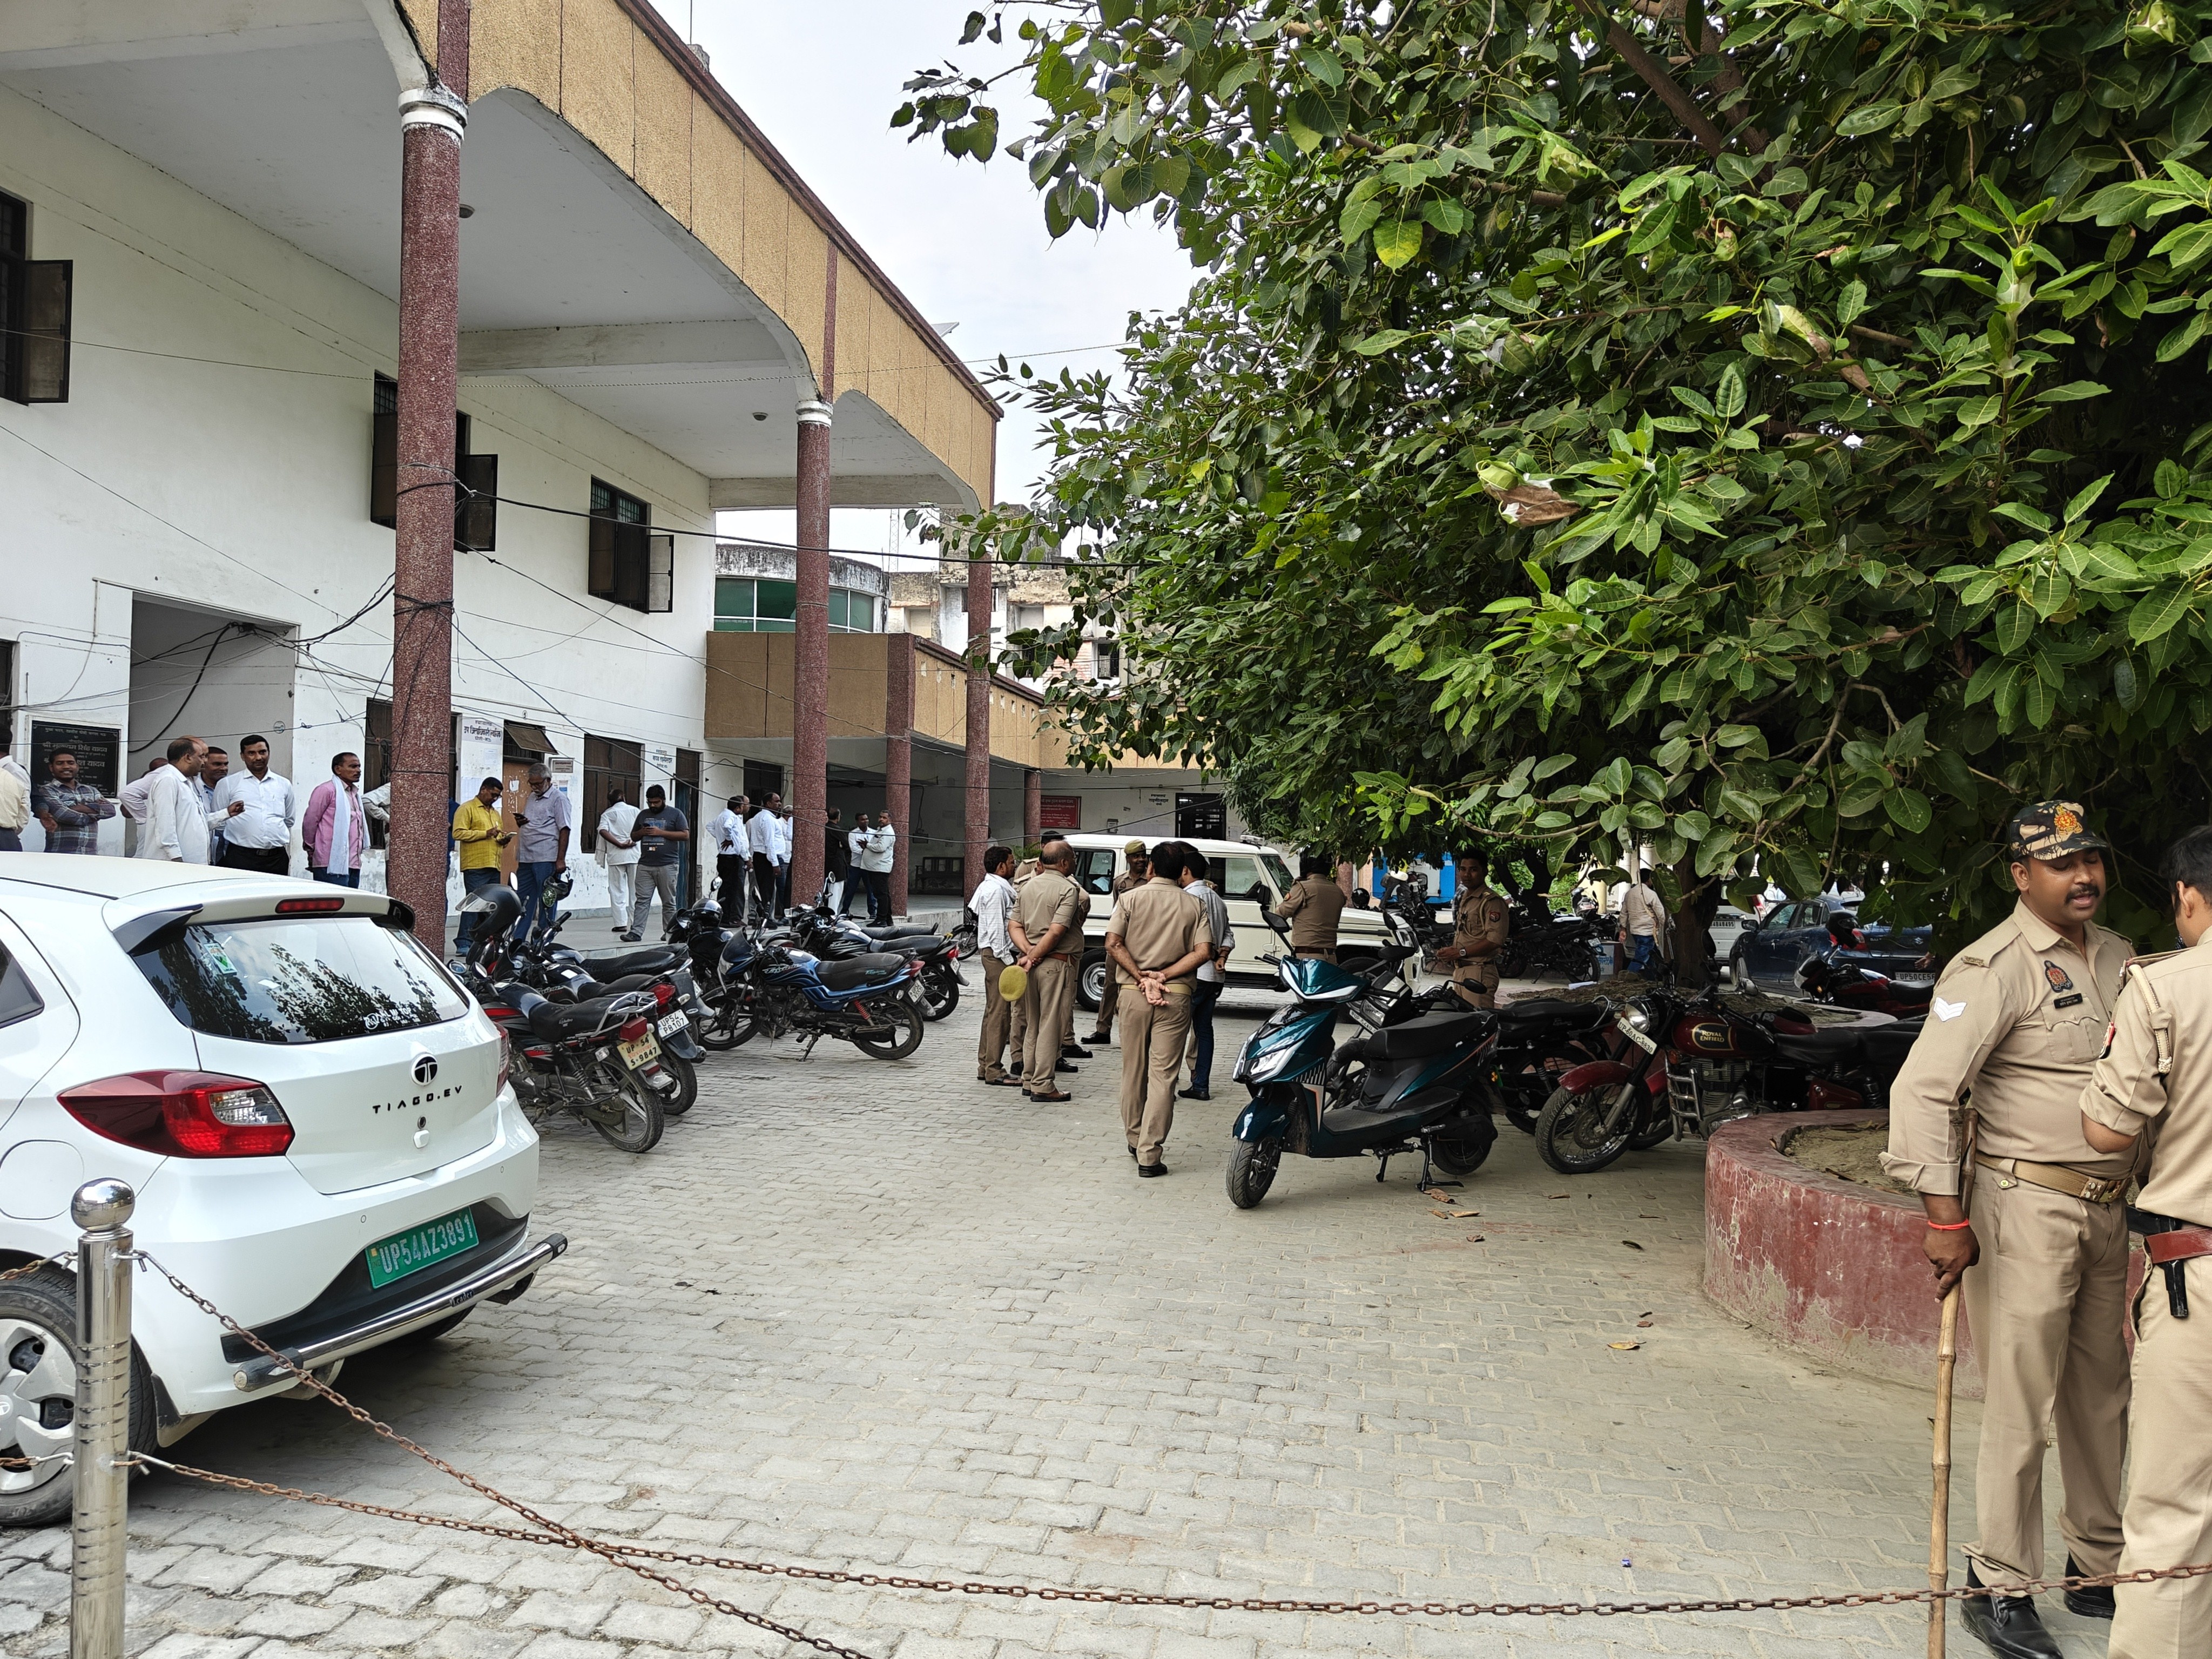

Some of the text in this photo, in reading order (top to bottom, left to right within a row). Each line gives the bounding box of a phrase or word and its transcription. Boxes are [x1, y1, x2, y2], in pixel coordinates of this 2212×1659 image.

[660, 1013, 679, 1027] UP54
[663, 1017, 684, 1034] P8107
[379, 1214, 473, 1273] UP54AZ3891
